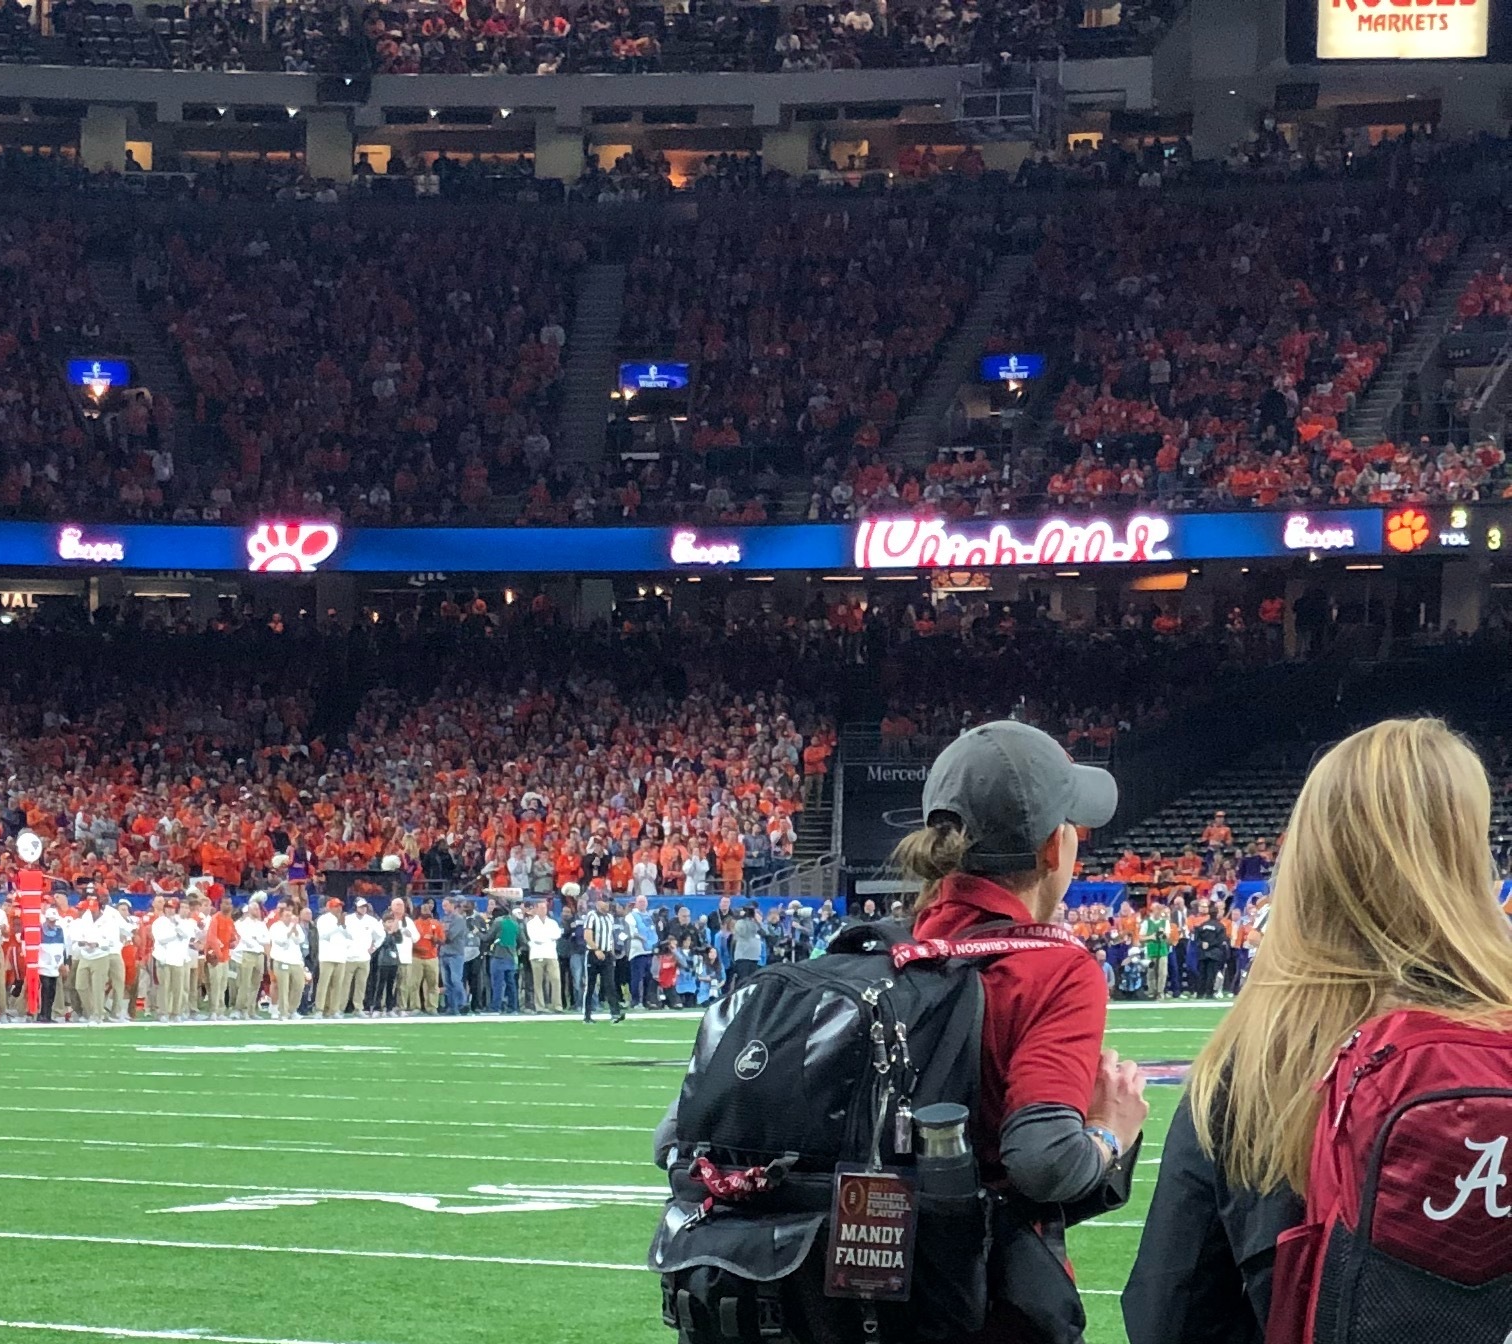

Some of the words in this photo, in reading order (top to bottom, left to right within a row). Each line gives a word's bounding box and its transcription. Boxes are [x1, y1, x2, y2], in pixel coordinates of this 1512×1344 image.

[1357, 13, 1449, 33] MARKETS
[1439, 533, 1470, 546] TOL
[866, 765, 931, 782] Merced
[841, 1224, 904, 1244] MANDY
[835, 1247, 904, 1268] FAUNDA
